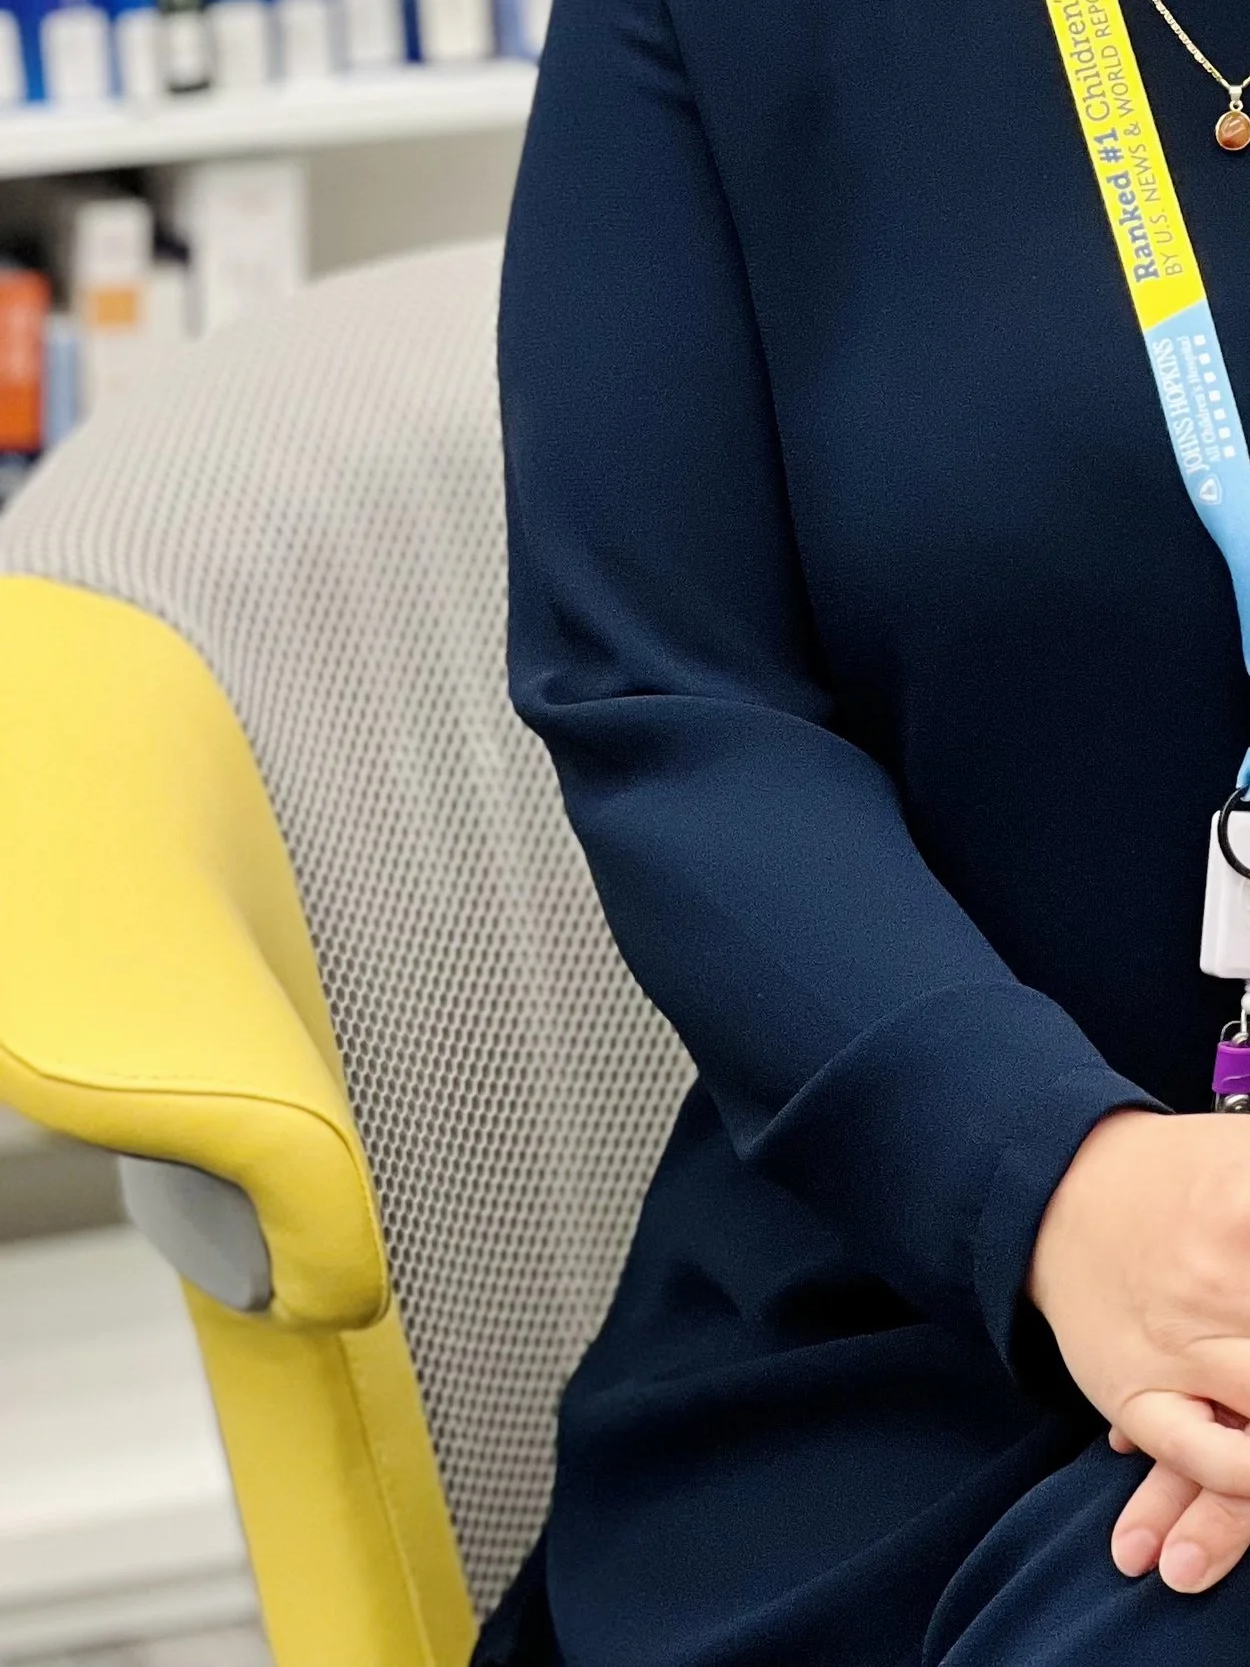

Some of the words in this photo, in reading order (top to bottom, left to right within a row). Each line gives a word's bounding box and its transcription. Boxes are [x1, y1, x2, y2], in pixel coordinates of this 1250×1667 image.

[1101, 44, 1134, 117] WORLD
[1093, 127, 1124, 164] #1
[1123, 121, 1142, 136] &
[1129, 143, 1161, 203] NEWS
[1106, 170, 1160, 283] Ranked
[1150, 208, 1174, 244] U.S.
[1160, 252, 1183, 276] BY
[1153, 337, 1191, 417] HOPKINS
[1173, 417, 1210, 473] JOHNS
